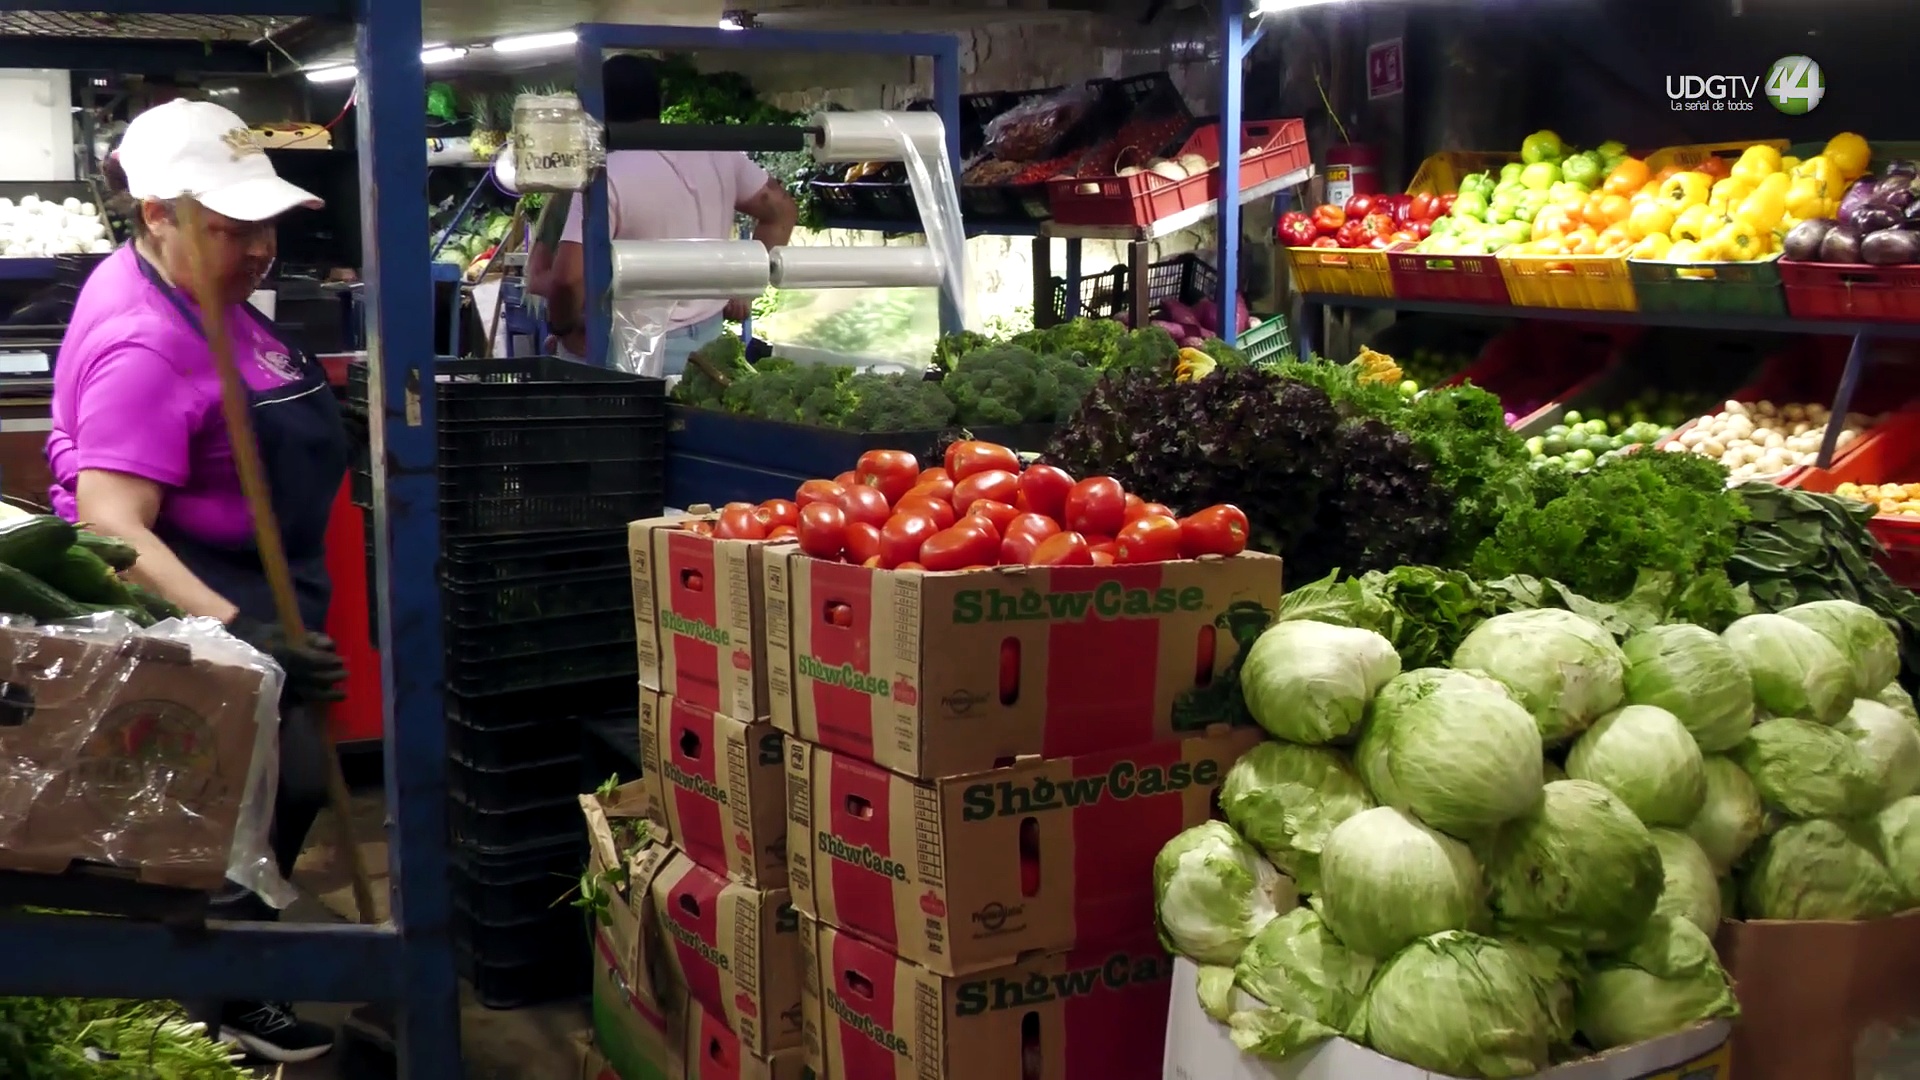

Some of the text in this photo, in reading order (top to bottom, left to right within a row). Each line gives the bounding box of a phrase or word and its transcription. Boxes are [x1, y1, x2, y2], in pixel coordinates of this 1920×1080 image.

[952, 581, 1205, 624] ShowCase
[661, 609, 730, 646] ShowCase
[798, 653, 890, 697] ShowCase
[963, 759, 1218, 822] ShowCase
[817, 831, 906, 881] ShowCase
